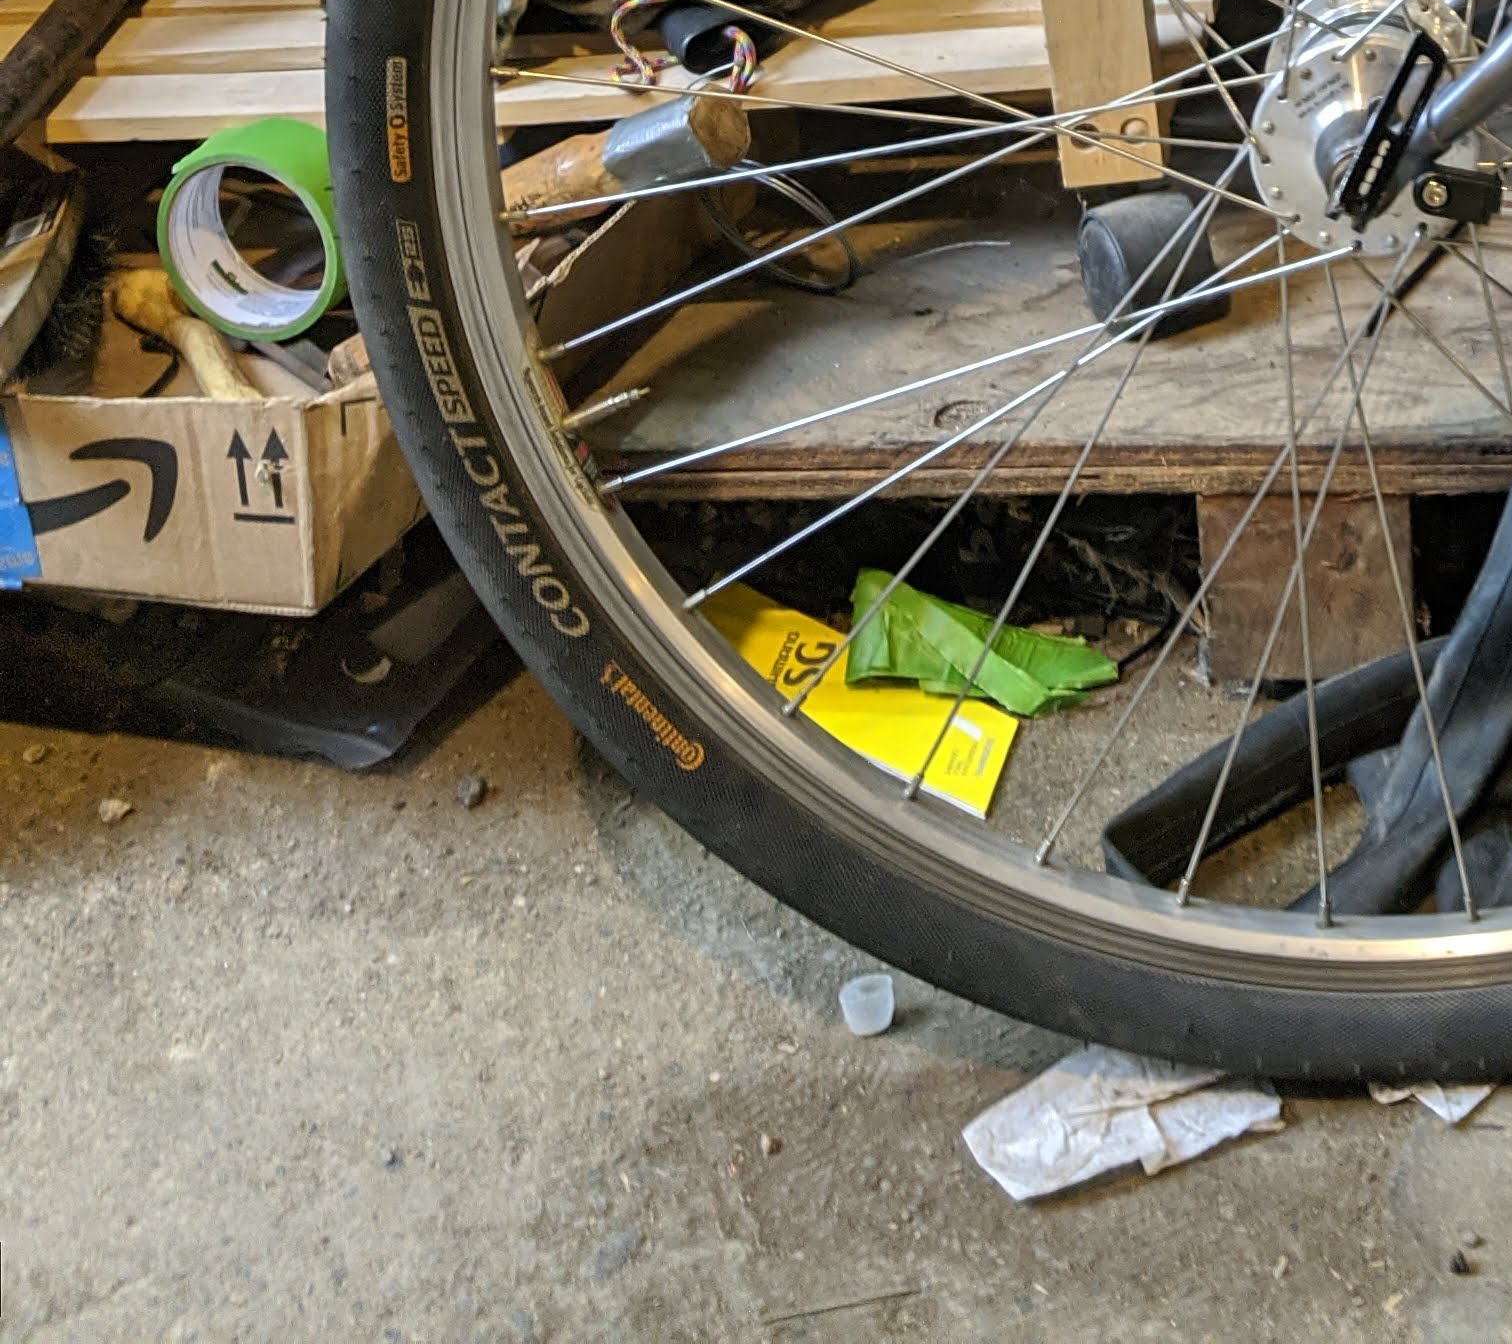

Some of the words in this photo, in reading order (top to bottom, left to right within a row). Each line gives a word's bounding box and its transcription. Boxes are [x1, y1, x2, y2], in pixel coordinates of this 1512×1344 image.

[388, 61, 405, 110] System
[391, 132, 410, 178] Safety
[422, 315, 469, 418] SPEED
[448, 424, 590, 637] CONTACT
[782, 639, 837, 694] SG
[612, 674, 706, 771] Continental
